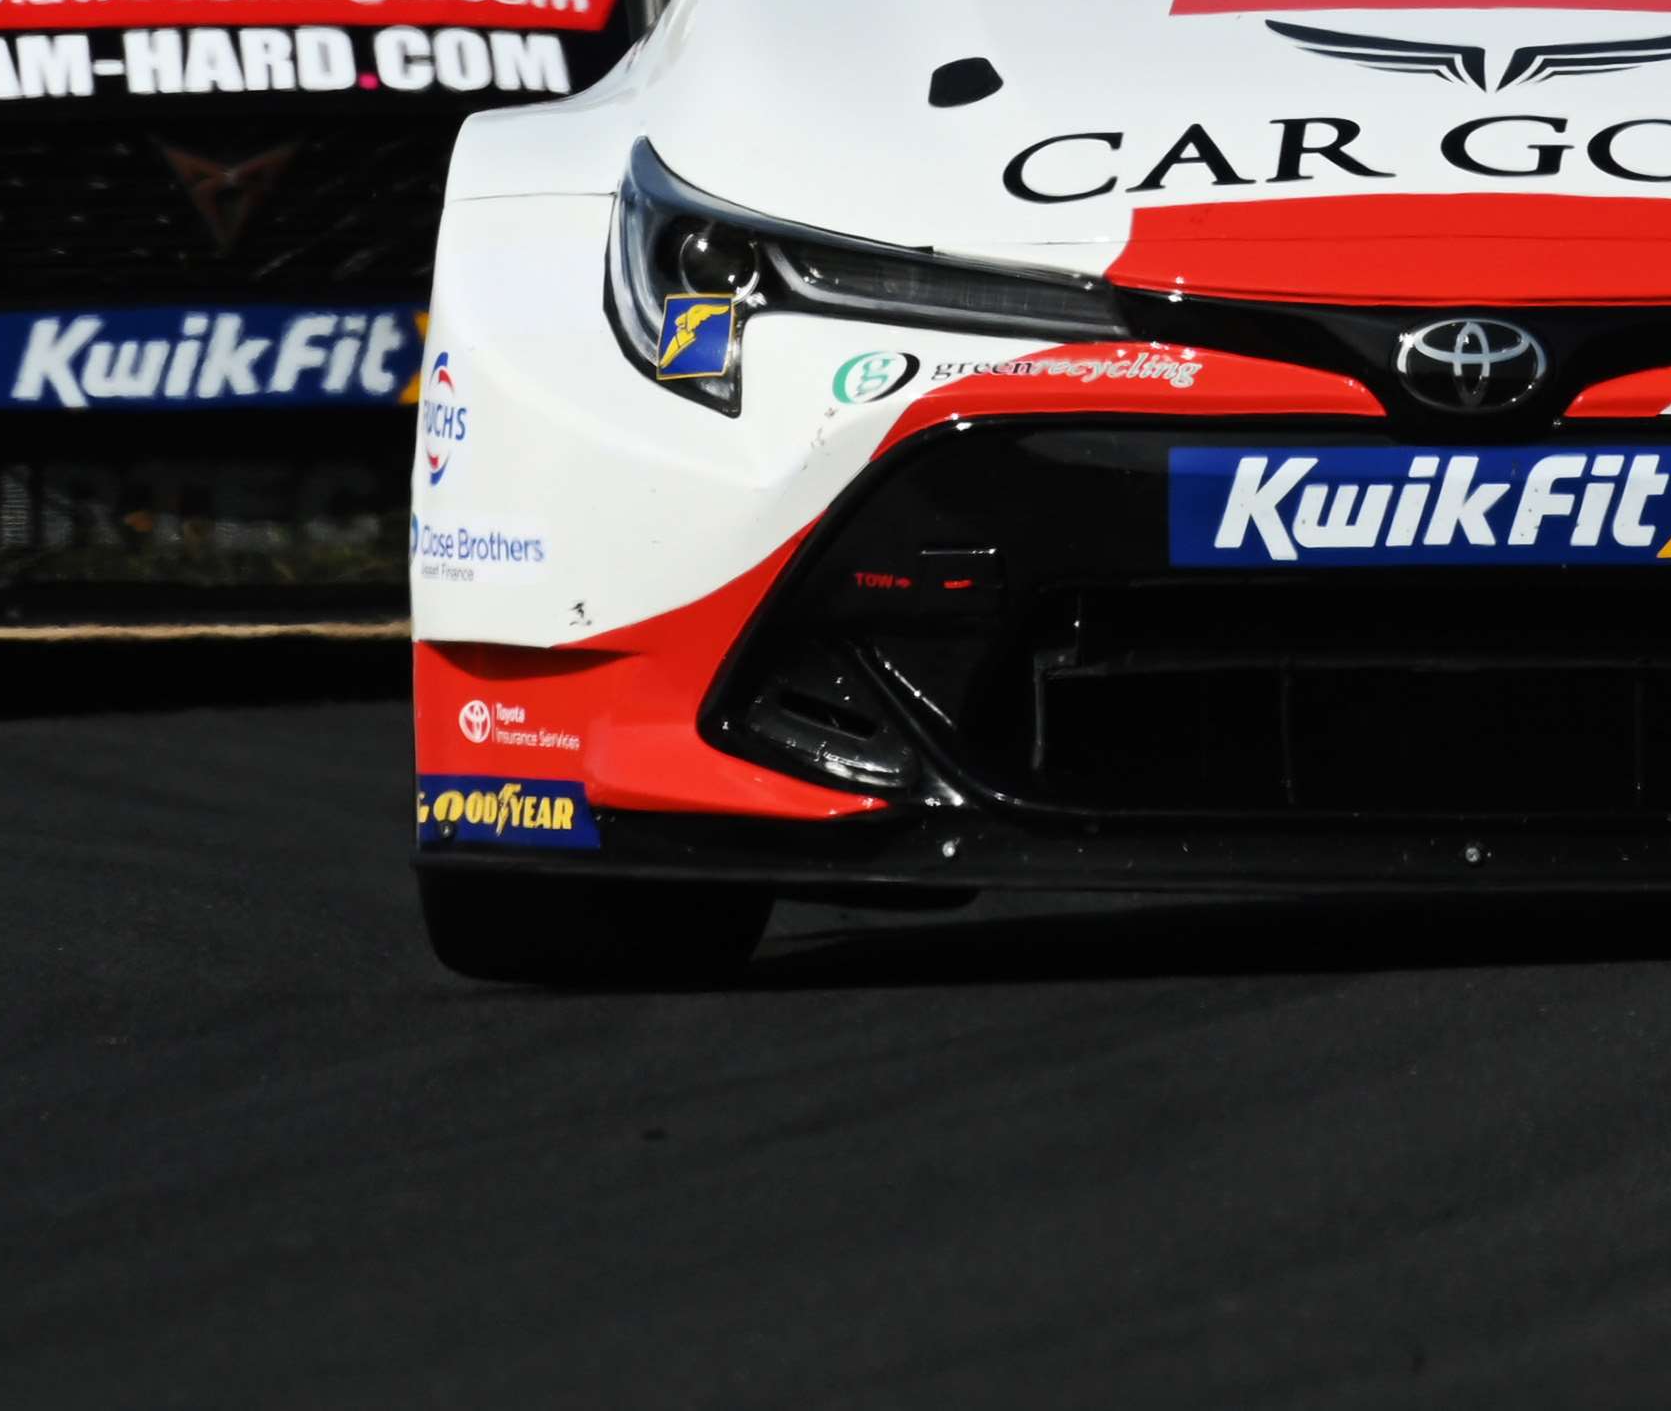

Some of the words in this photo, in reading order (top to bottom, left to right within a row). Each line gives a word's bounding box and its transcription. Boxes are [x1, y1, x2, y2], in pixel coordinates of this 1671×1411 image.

[1002, 116, 1395, 204] CAR
[11, 312, 405, 408] KwikFit
[930, 352, 1204, 388] greenrecycling
[1214, 454, 1670, 561] KwikFit
[458, 529, 545, 563] Brothers
[495, 702, 526, 724] Toyota
